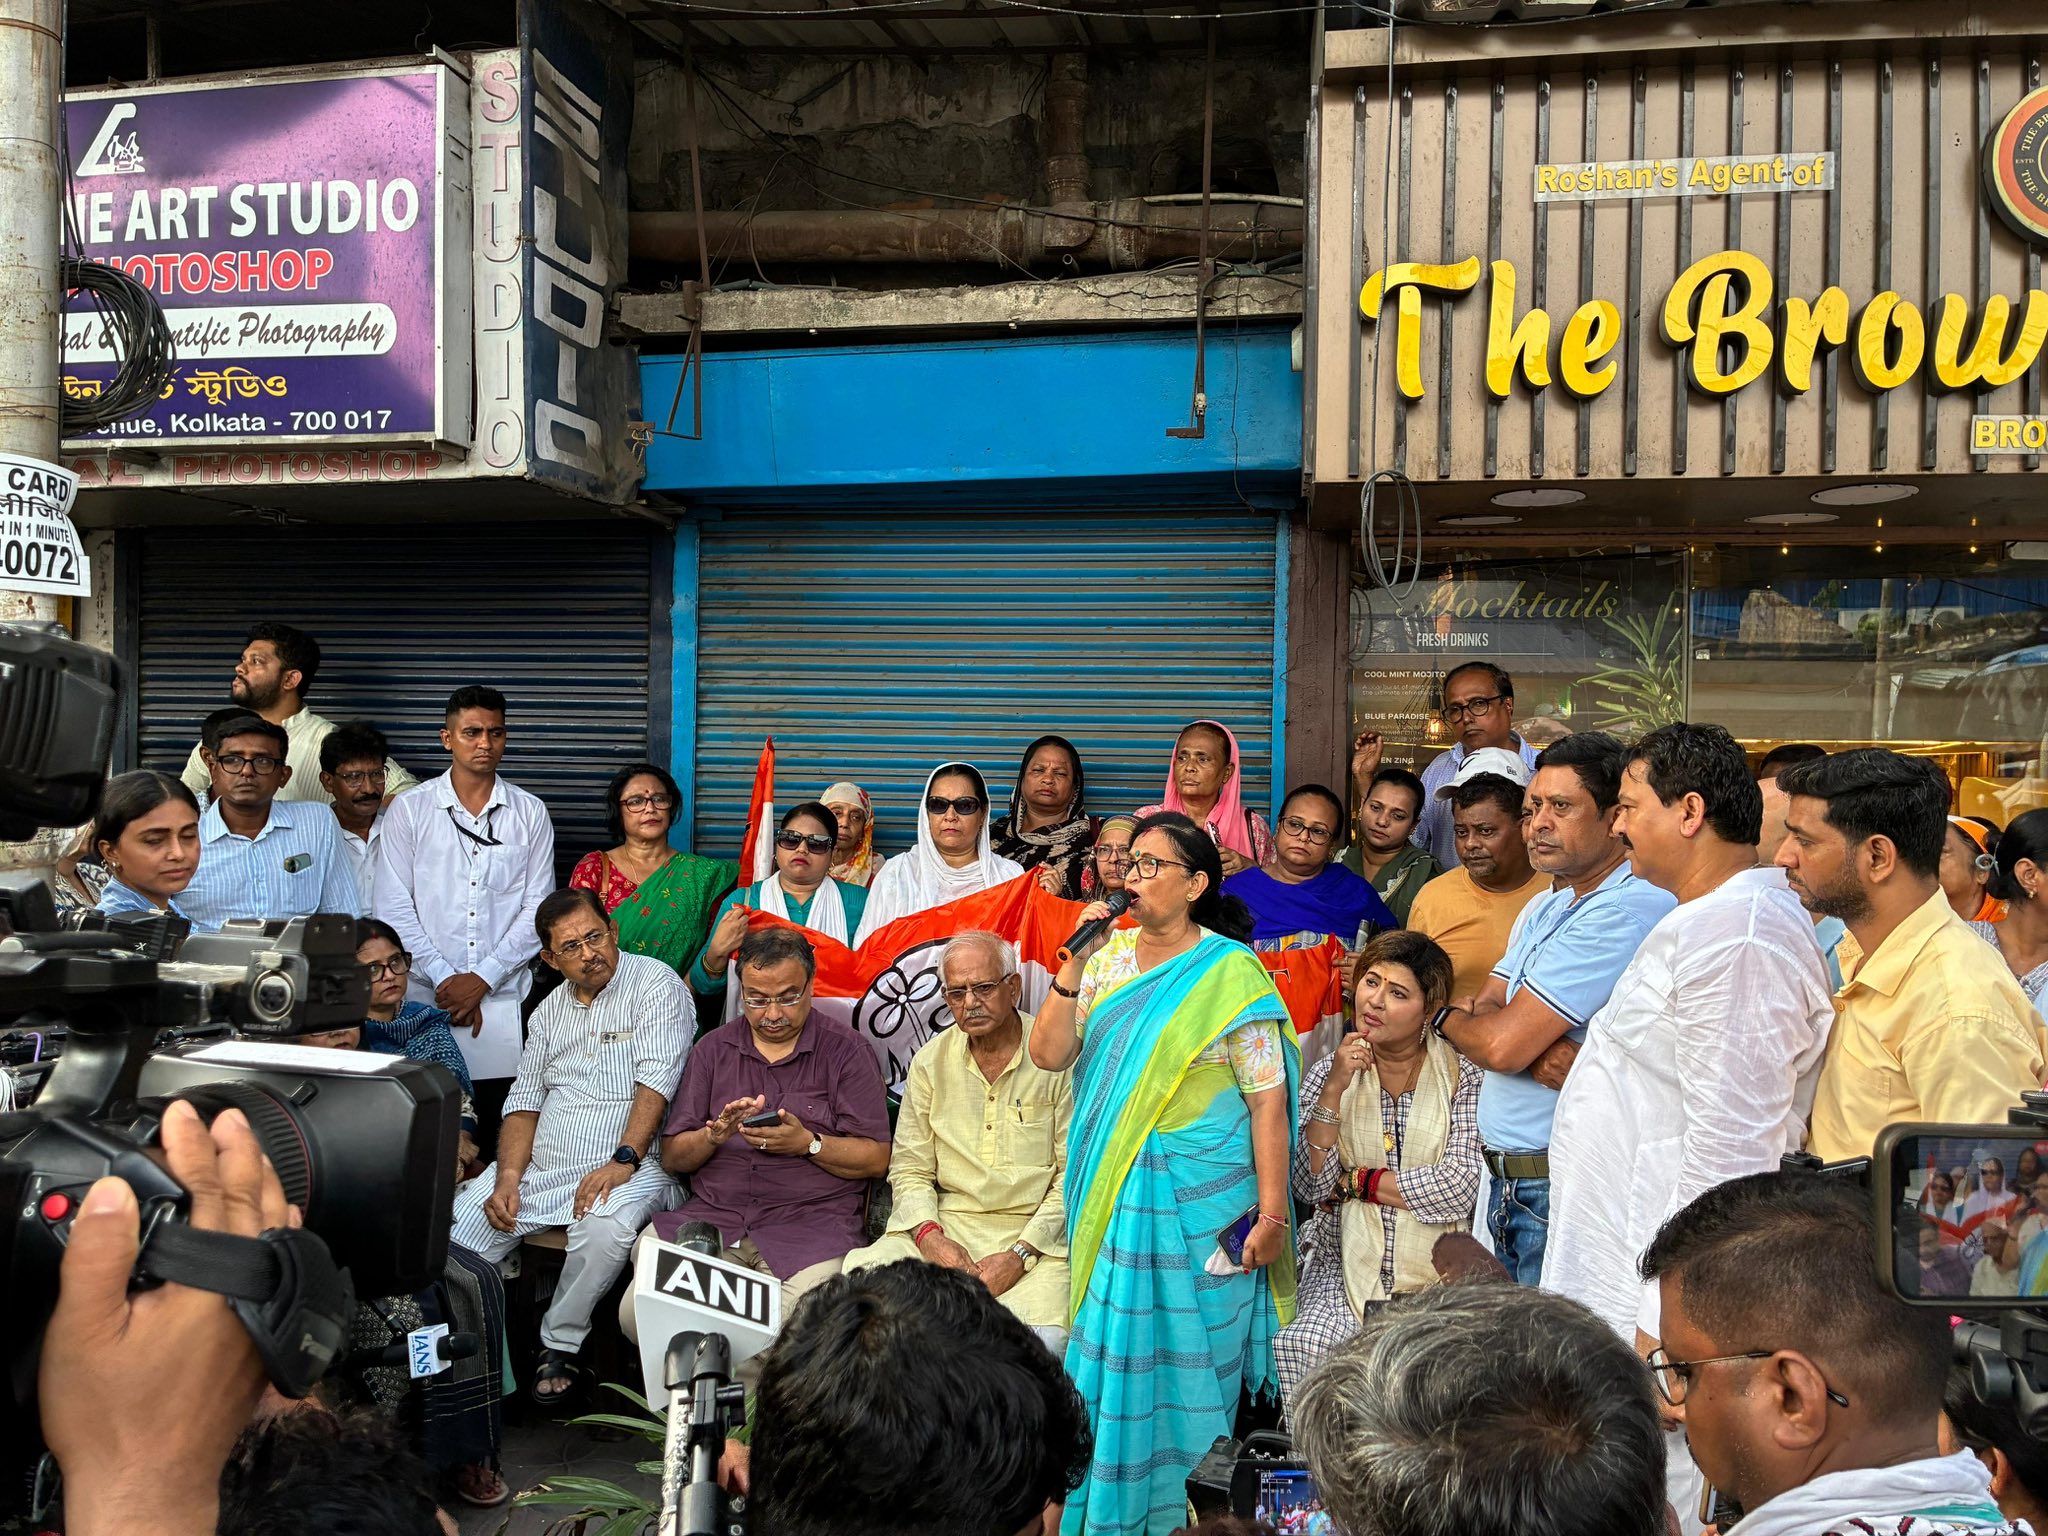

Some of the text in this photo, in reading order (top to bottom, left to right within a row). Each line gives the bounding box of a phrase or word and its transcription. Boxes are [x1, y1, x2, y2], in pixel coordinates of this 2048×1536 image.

[2021, 127, 2038, 151] THE
[1537, 156, 1826, 193] Roshan's Agent of
[2021, 169, 2038, 194] THE
[124, 185, 218, 242] ART
[230, 177, 419, 237] STUDIO
[479, 60, 523, 468] STUDIO
[238, 310, 385, 355] Photography
[1359, 255, 1622, 402] The
[171, 411, 266, 434] Kolkata
[289, 410, 337, 431] 700
[344, 409, 393, 430] 017
[8, 467, 70, 502] CARD
[66, 450, 443, 486] AL PHOTOSHOP
[9, 520, 22, 537] IN
[26, 522, 32, 538] 1
[36, 523, 70, 544] MINUTE
[0, 539, 75, 580] 0072
[1416, 632, 1489, 647] FRESH DRINKS
[1364, 671, 1388, 679] COOL
[1364, 712, 1387, 720] BLUE
[661, 1258, 763, 1321] ANI
[414, 1335, 431, 1374] IANS
